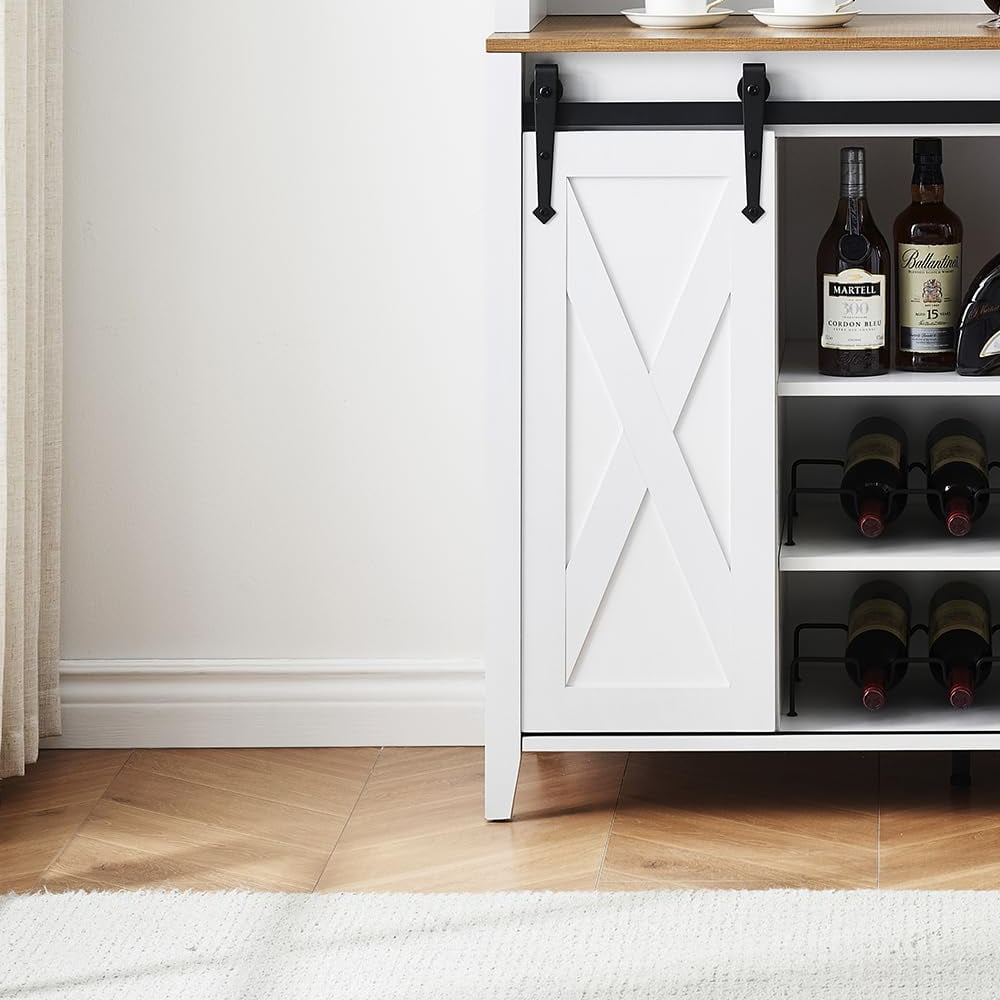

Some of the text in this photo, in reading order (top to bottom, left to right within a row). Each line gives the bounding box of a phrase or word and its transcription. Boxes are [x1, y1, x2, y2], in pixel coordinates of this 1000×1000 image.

[902, 248, 960, 270] Ballantine'
[833, 286, 877, 295] MARTELL
[841, 302, 869, 315] 300
[926, 310, 939, 320] 15
